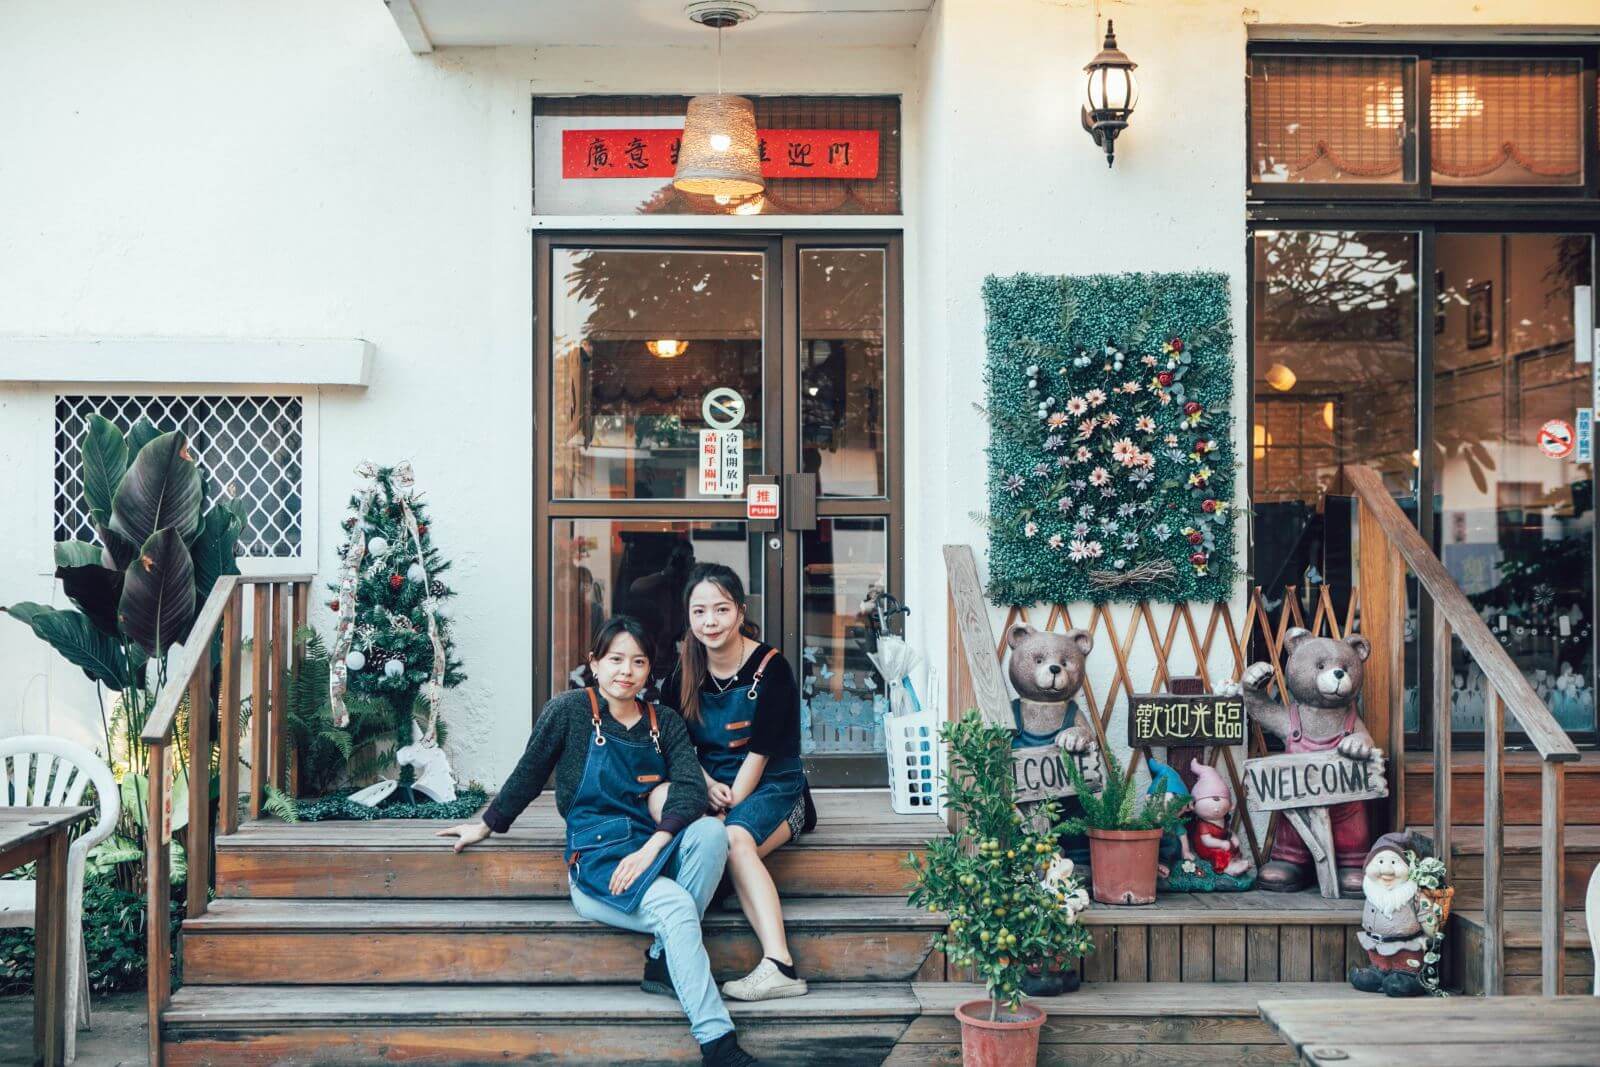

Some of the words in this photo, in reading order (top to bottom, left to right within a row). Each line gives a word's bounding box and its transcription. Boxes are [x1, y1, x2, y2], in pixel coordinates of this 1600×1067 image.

[704, 432, 717, 491] 請隨手關門
[726, 432, 738, 492] 冷氣開放中
[751, 507, 775, 515] PUSH
[757, 490, 769, 502] 推
[1136, 702, 1242, 739] 歡迎光臨
[1250, 760, 1377, 803] WELCOME
